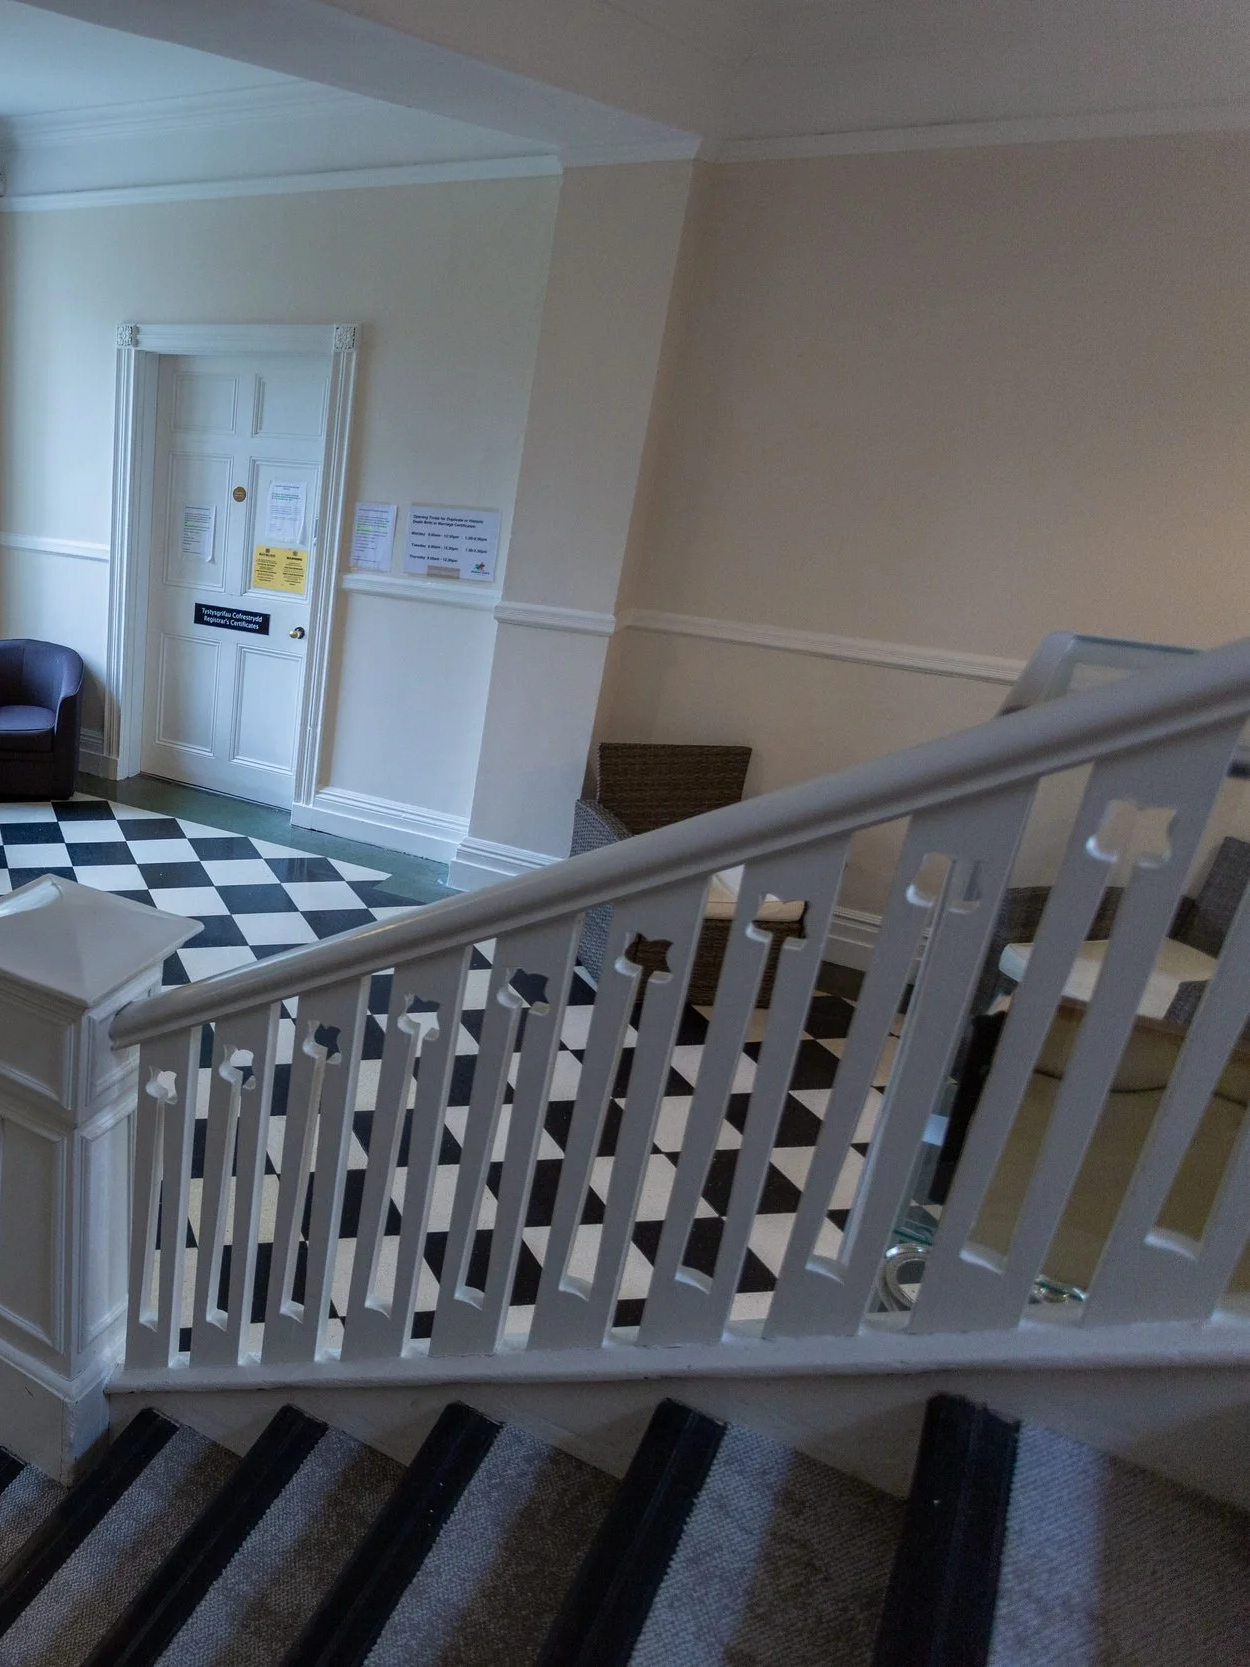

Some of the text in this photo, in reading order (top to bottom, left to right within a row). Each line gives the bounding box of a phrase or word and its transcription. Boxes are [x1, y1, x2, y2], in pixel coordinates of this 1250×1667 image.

[201, 607, 263, 622] Tystysgrifau Cofrestrydd
[203, 615, 259, 629] Registrar's Certificates
